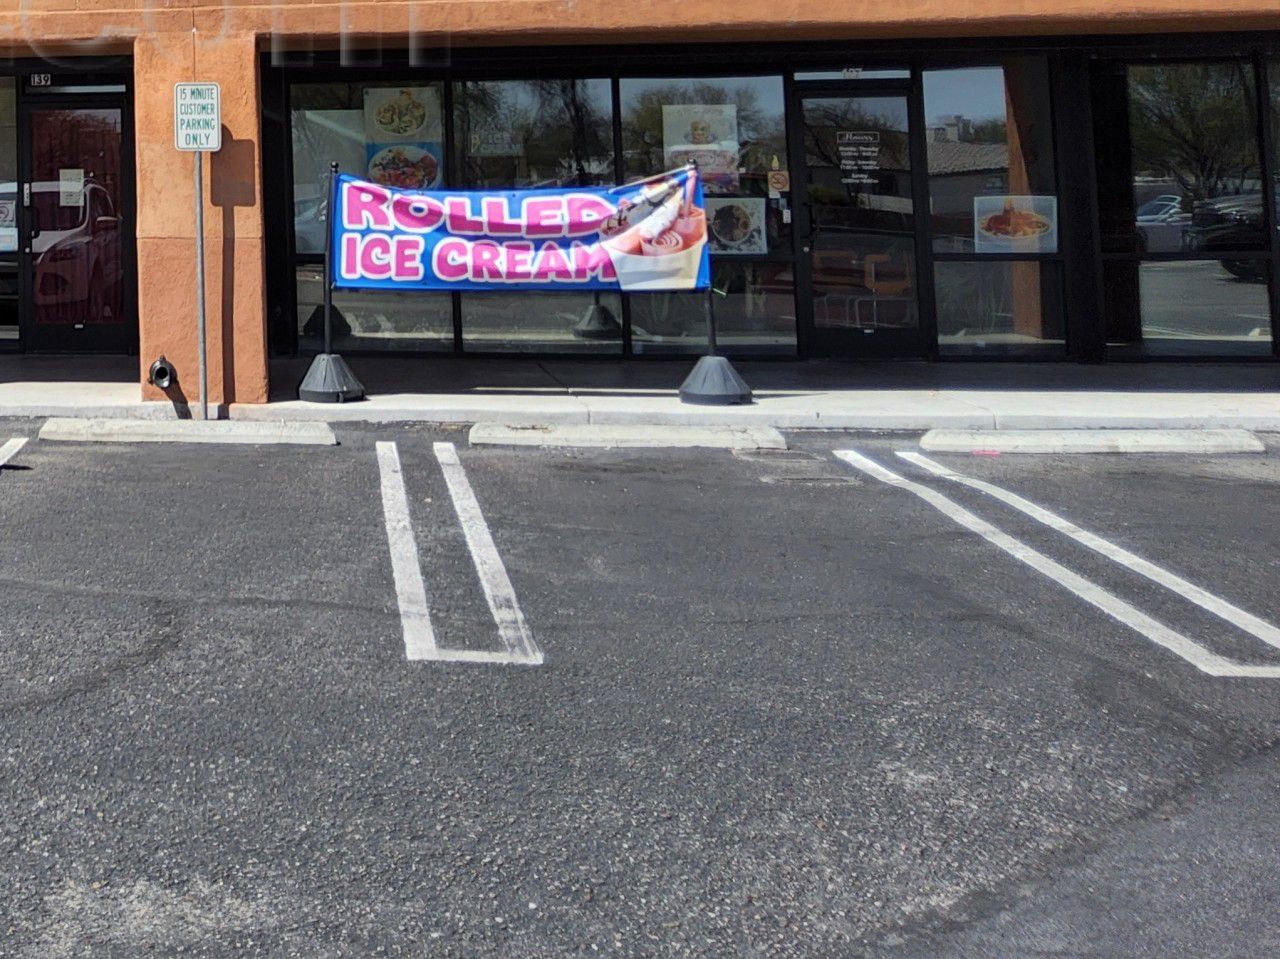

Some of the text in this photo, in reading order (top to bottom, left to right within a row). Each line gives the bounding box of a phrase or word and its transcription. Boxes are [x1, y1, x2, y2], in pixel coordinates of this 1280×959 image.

[32, 74, 50, 85] 139
[180, 87, 215, 100] 15 MINUTE
[180, 103, 215, 116] CUSTOMER
[180, 118, 215, 131] PARKING
[185, 133, 210, 145] ONLY
[342, 183, 617, 237] ROLLED
[341, 233, 617, 283] ICE CREAM
